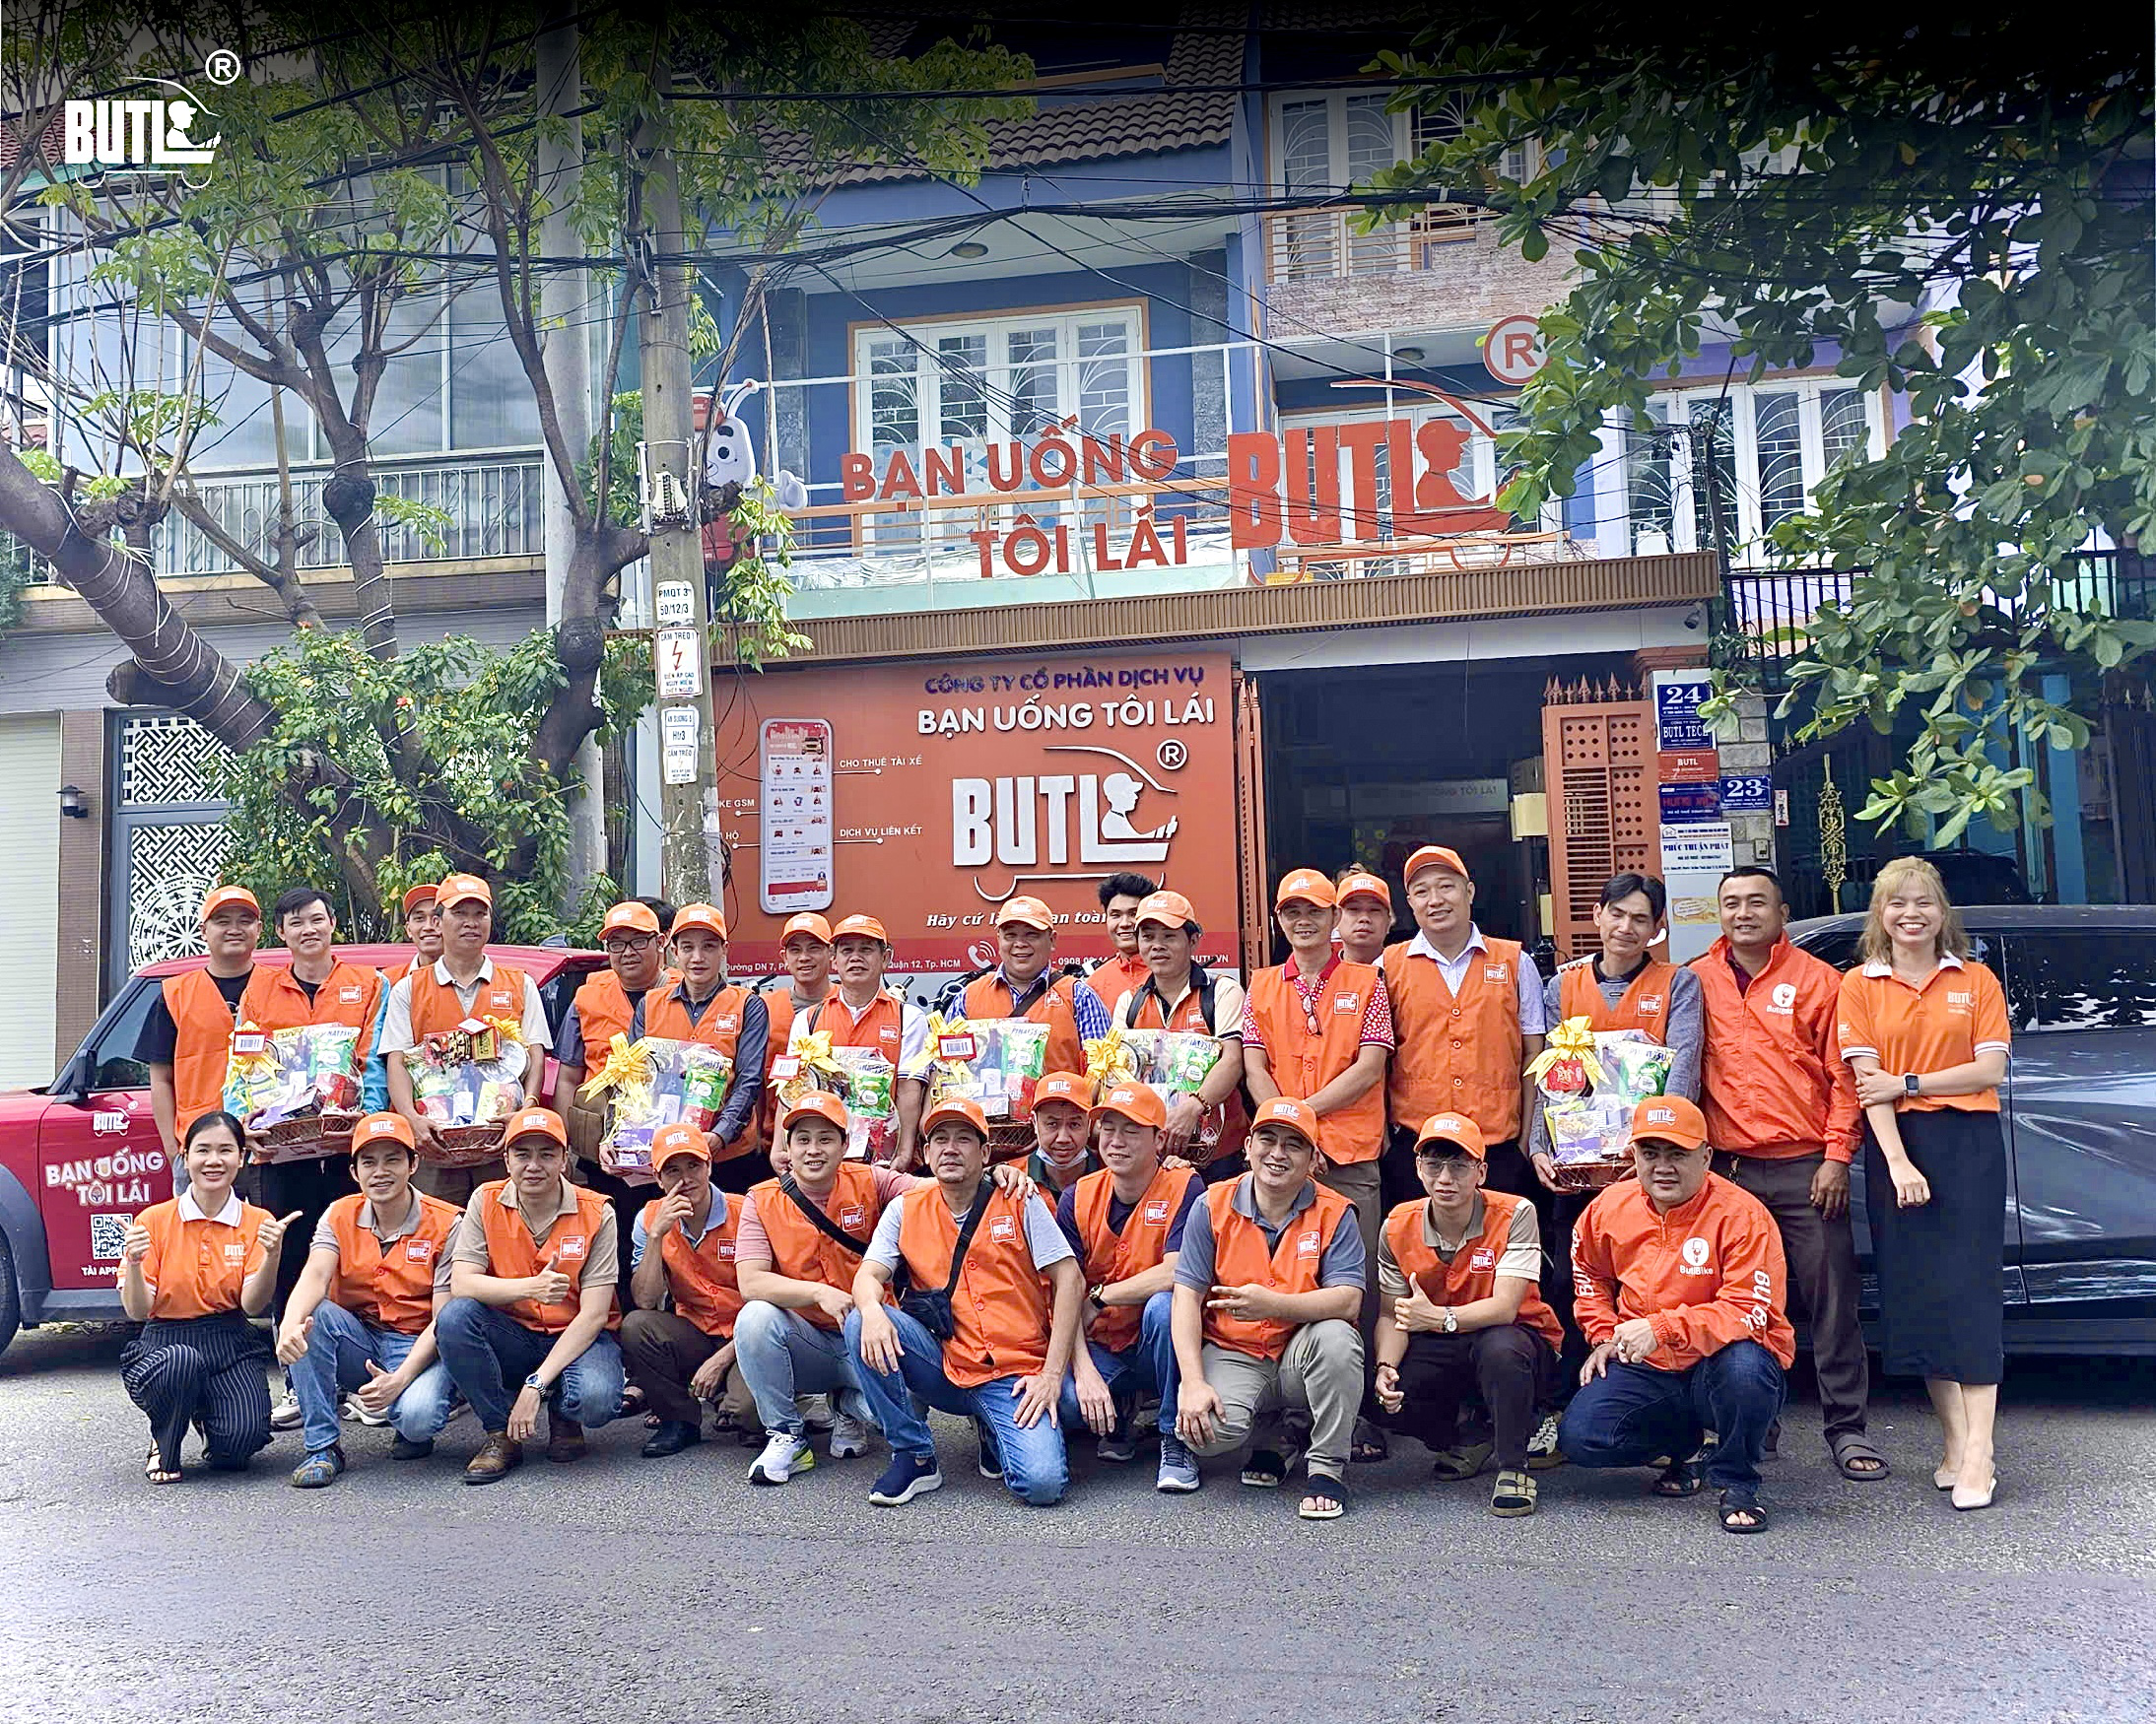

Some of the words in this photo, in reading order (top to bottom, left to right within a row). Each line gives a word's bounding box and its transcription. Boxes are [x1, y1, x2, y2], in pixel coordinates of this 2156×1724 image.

[842, 445, 966, 512] BẠN
[986, 414, 1179, 492] UỐNG
[1228, 419, 1511, 549] BUTL
[971, 513, 1069, 578] TÔI
[1094, 503, 1187, 571] LÁI
[925, 673, 985, 694] CÔNG
[989, 674, 1016, 693] TY
[1020, 666, 1049, 691] CỔ
[1054, 666, 1113, 690] PHẦN
[1118, 669, 1170, 690] DỊCH
[1174, 666, 1204, 688] VỤ
[1665, 686, 1702, 703] 24
[917, 707, 985, 739] BẠN
[993, 694, 1094, 731] UỐNG
[1101, 694, 1155, 727] TÔI
[1164, 692, 1215, 725] LÁI
[1663, 727, 1685, 738] BUTL
[840, 759, 860, 768] CHO
[891, 755, 906, 766] TÀI
[1727, 779, 1765, 797] 23
[719, 799, 732, 808] KE
[734, 799, 755, 808] GSM
[840, 829, 862, 838] DỊCH
[865, 829, 878, 838] VỤ
[881, 826, 902, 835] LIÊN
[904, 824, 923, 835] KẾT
[952, 774, 1171, 867] BUTL
[926, 914, 958, 929] Hãy
[963, 912, 984, 926] cứ
[940, 959, 961, 968] HCM
[45, 1160, 92, 1190] BẠN
[76, 1181, 112, 1206] TÔI
[118, 1179, 151, 1203] LÁI
